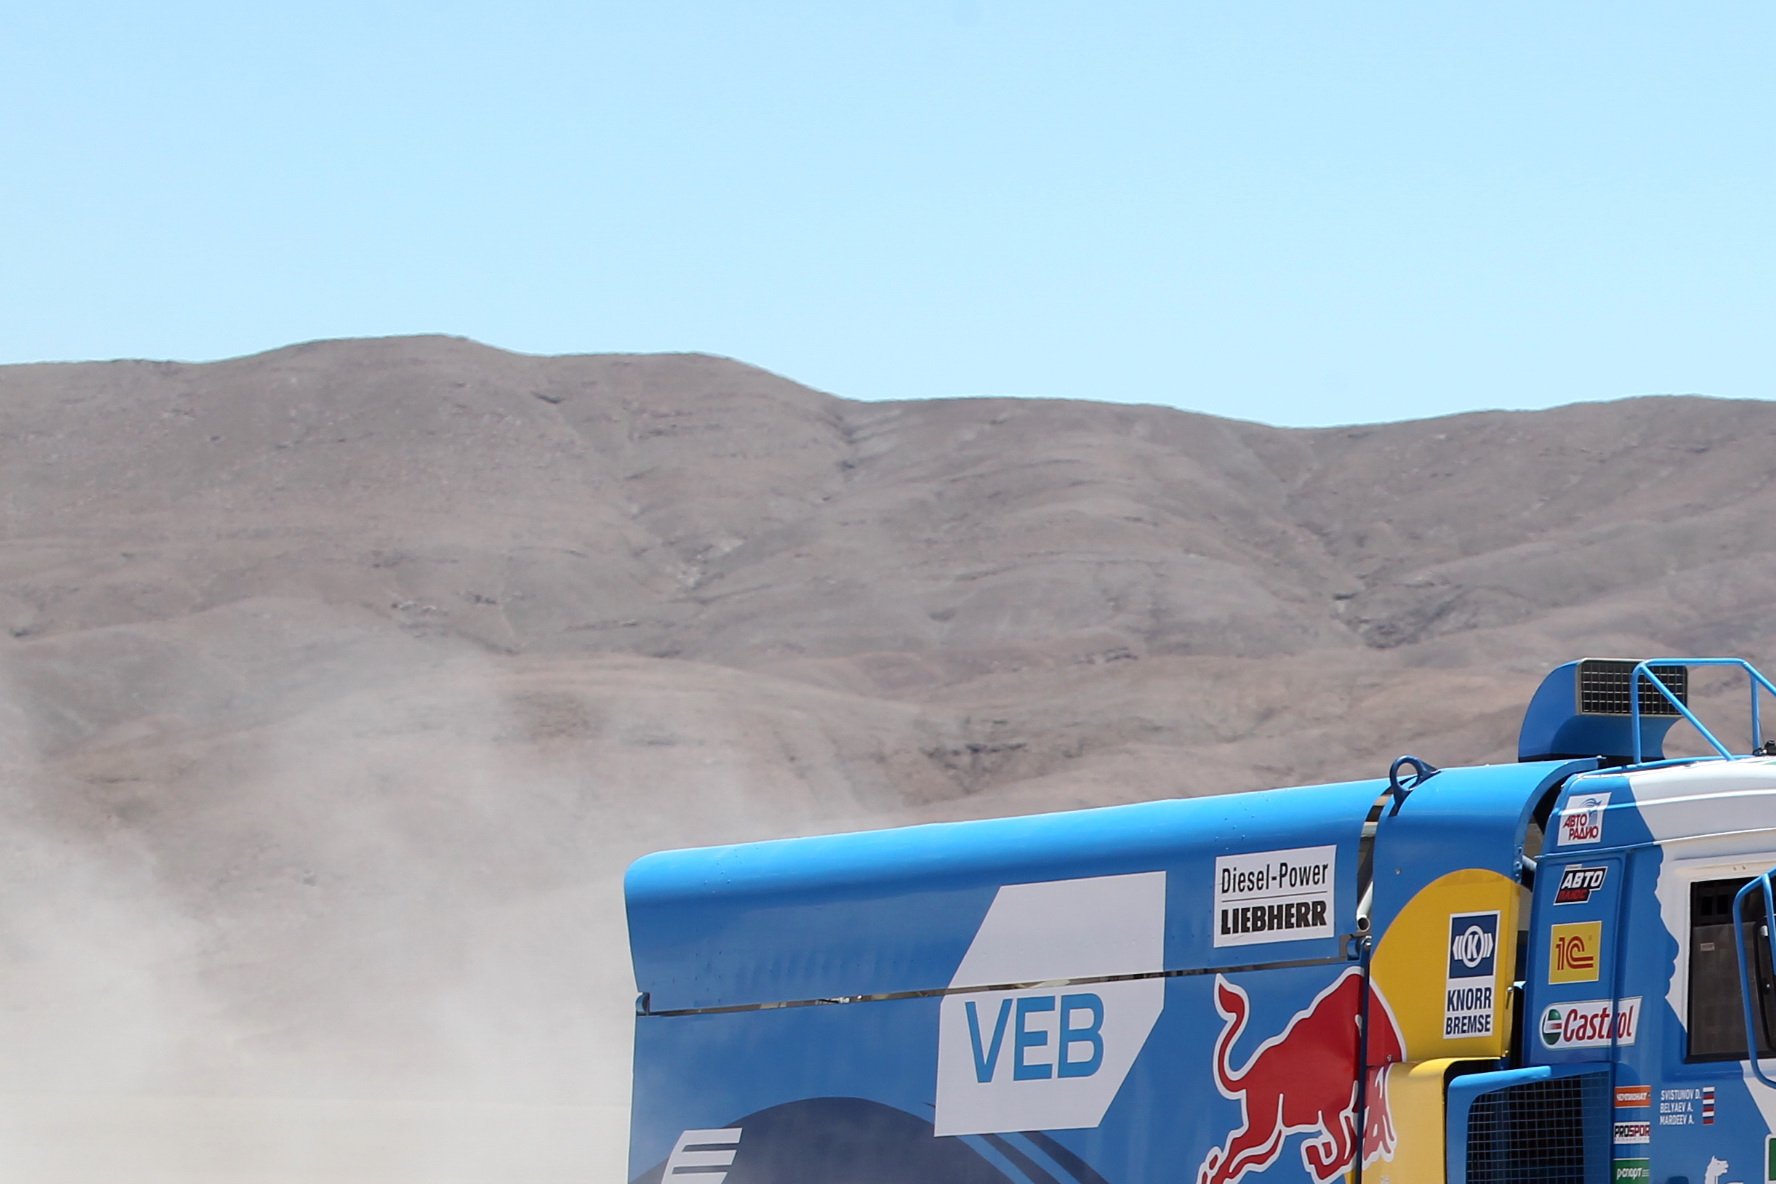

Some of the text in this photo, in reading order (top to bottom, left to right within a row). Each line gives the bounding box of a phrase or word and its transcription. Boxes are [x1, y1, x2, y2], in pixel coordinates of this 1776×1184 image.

[1562, 813, 1588, 828] АВТО
[1568, 825, 1599, 841] РАДИО
[1221, 862, 1329, 894] Diesel-Power
[1561, 870, 1604, 889] АВТО
[1221, 900, 1327, 935] LIEBHERR
[1447, 986, 1492, 1012] KNORR
[1445, 1014, 1491, 1035] BREMSE
[965, 992, 1105, 1083] VEB
[1661, 1089, 1694, 1101] SVISTUNOV
[1660, 1101, 1694, 1113] BELYAEV A.
[1687, 1114, 1695, 1125] A.
[1614, 1125, 1650, 1138] PROSPOR
